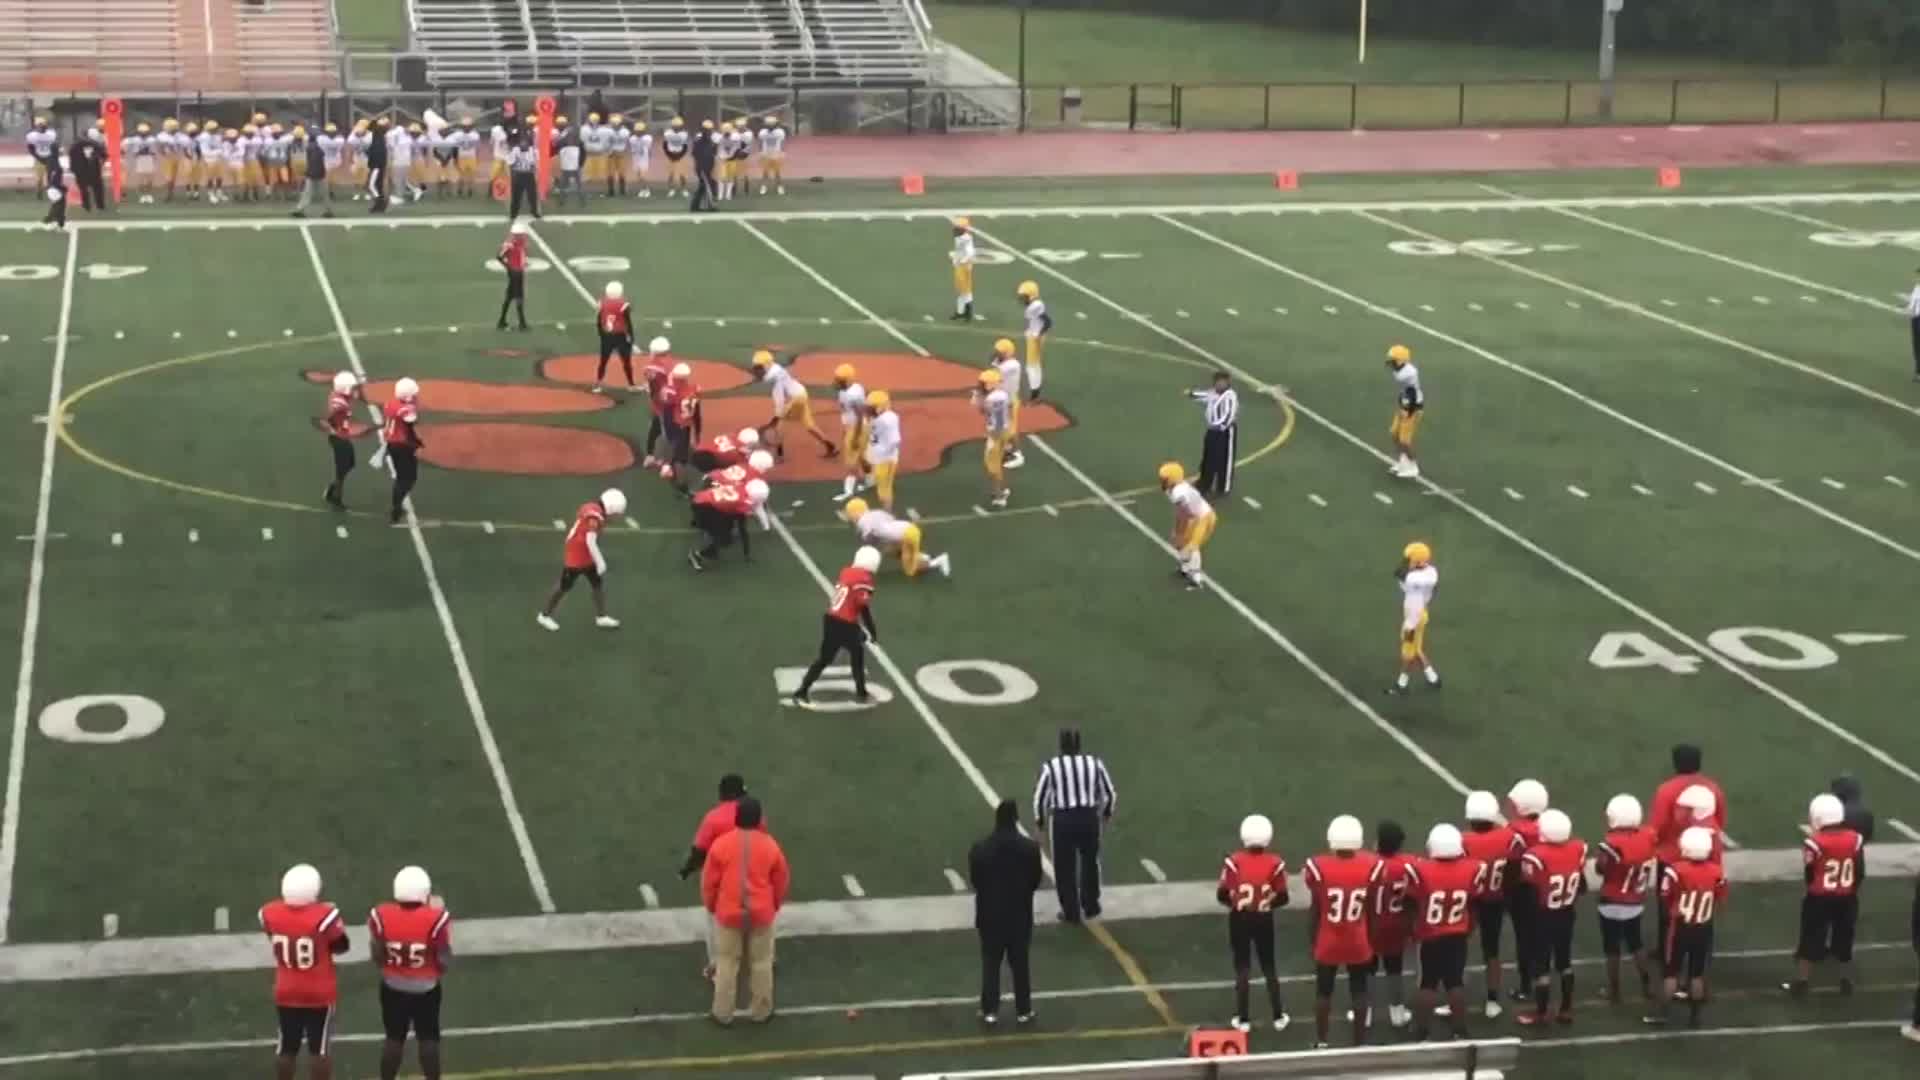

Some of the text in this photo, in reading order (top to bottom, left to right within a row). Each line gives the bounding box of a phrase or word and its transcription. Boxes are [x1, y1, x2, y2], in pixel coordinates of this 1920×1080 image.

[1589, 626, 1839, 673] 40
[773, 659, 1039, 712] 50
[1547, 872, 1580, 909] 29
[1823, 858, 1853, 889] 20
[1327, 887, 1367, 923] 36
[1426, 890, 1467, 925] 62
[1679, 890, 1713, 924] 40
[272, 934, 314, 969] 78
